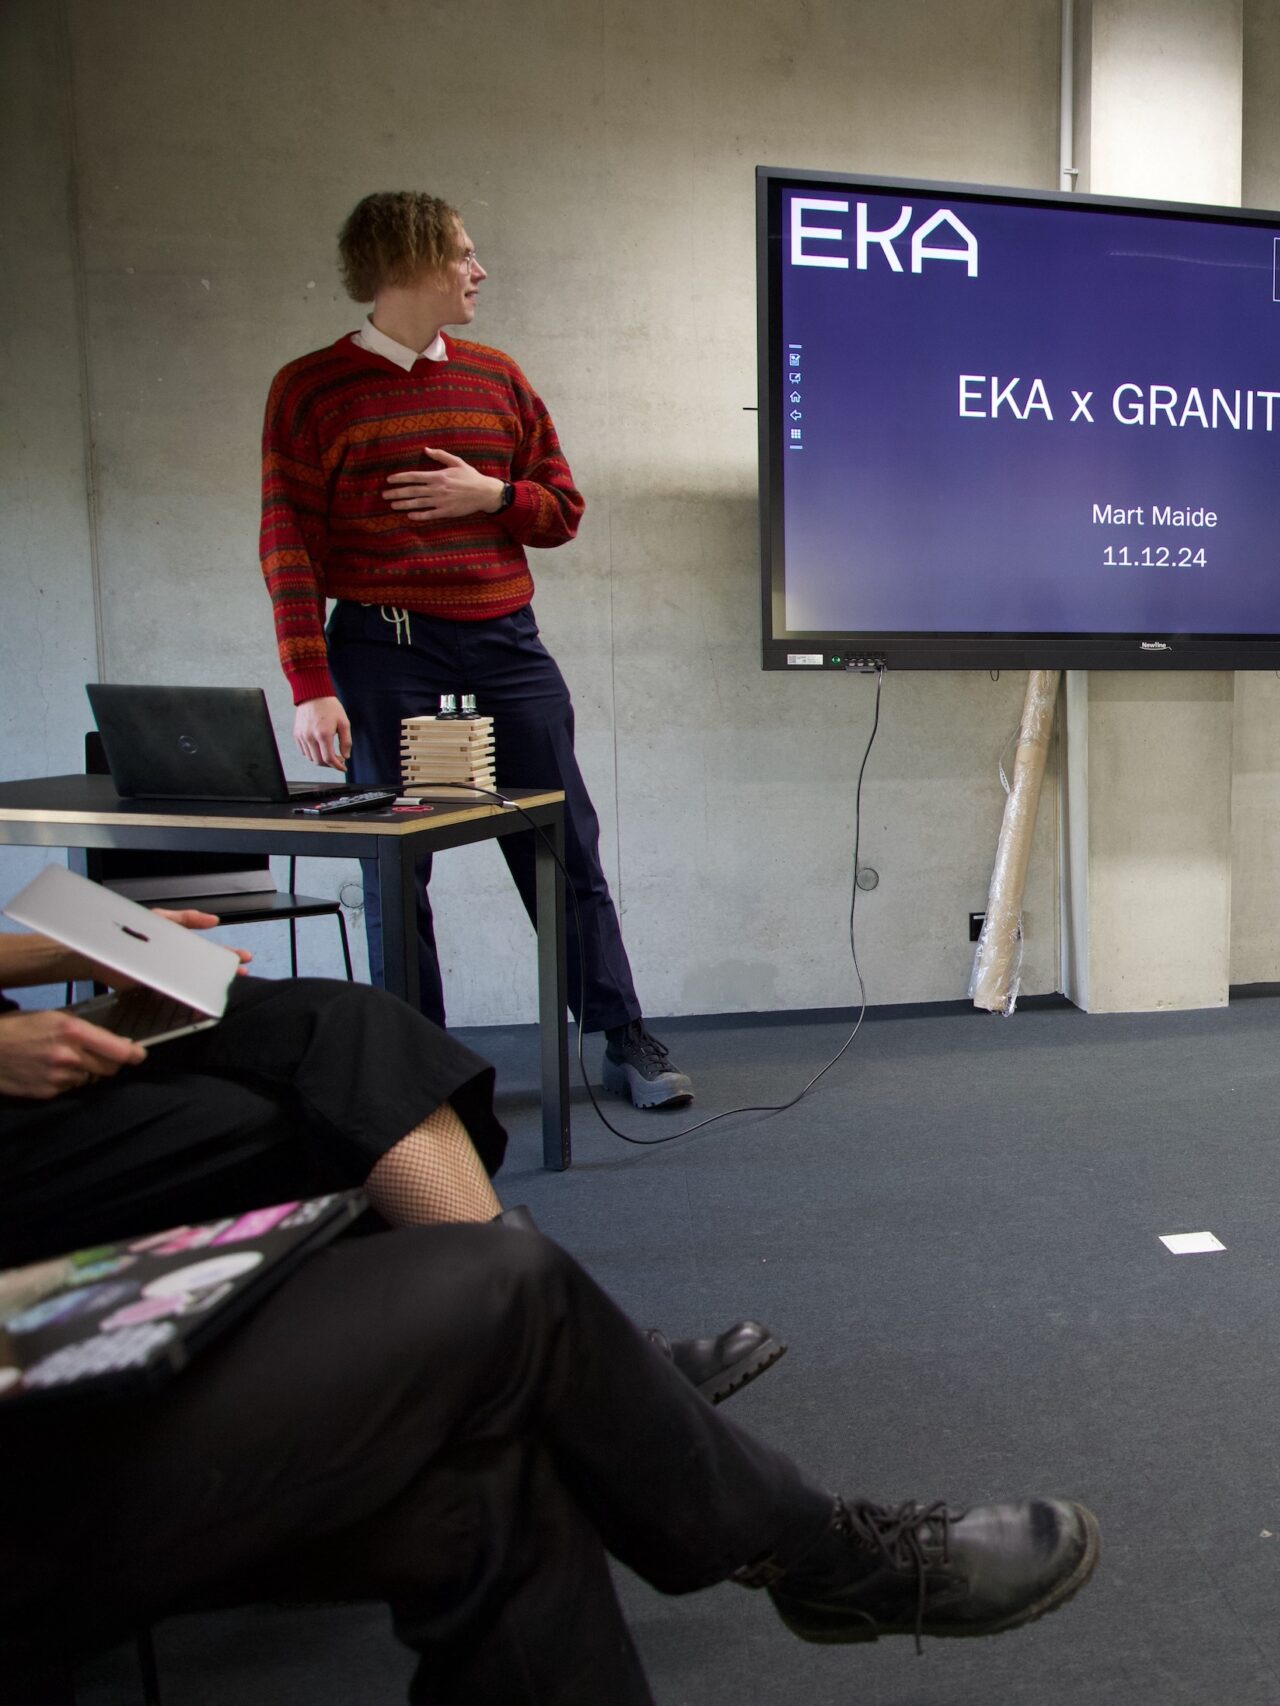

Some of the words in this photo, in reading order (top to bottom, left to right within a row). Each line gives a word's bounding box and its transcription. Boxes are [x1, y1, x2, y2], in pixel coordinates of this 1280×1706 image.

[790, 197, 979, 278] EKA
[958, 375, 1054, 421] EKA
[1070, 391, 1095, 423] x
[1092, 504, 1145, 526] Mart
[1152, 505, 1218, 528] Maide
[1102, 546, 1208, 568] 11.12.24
